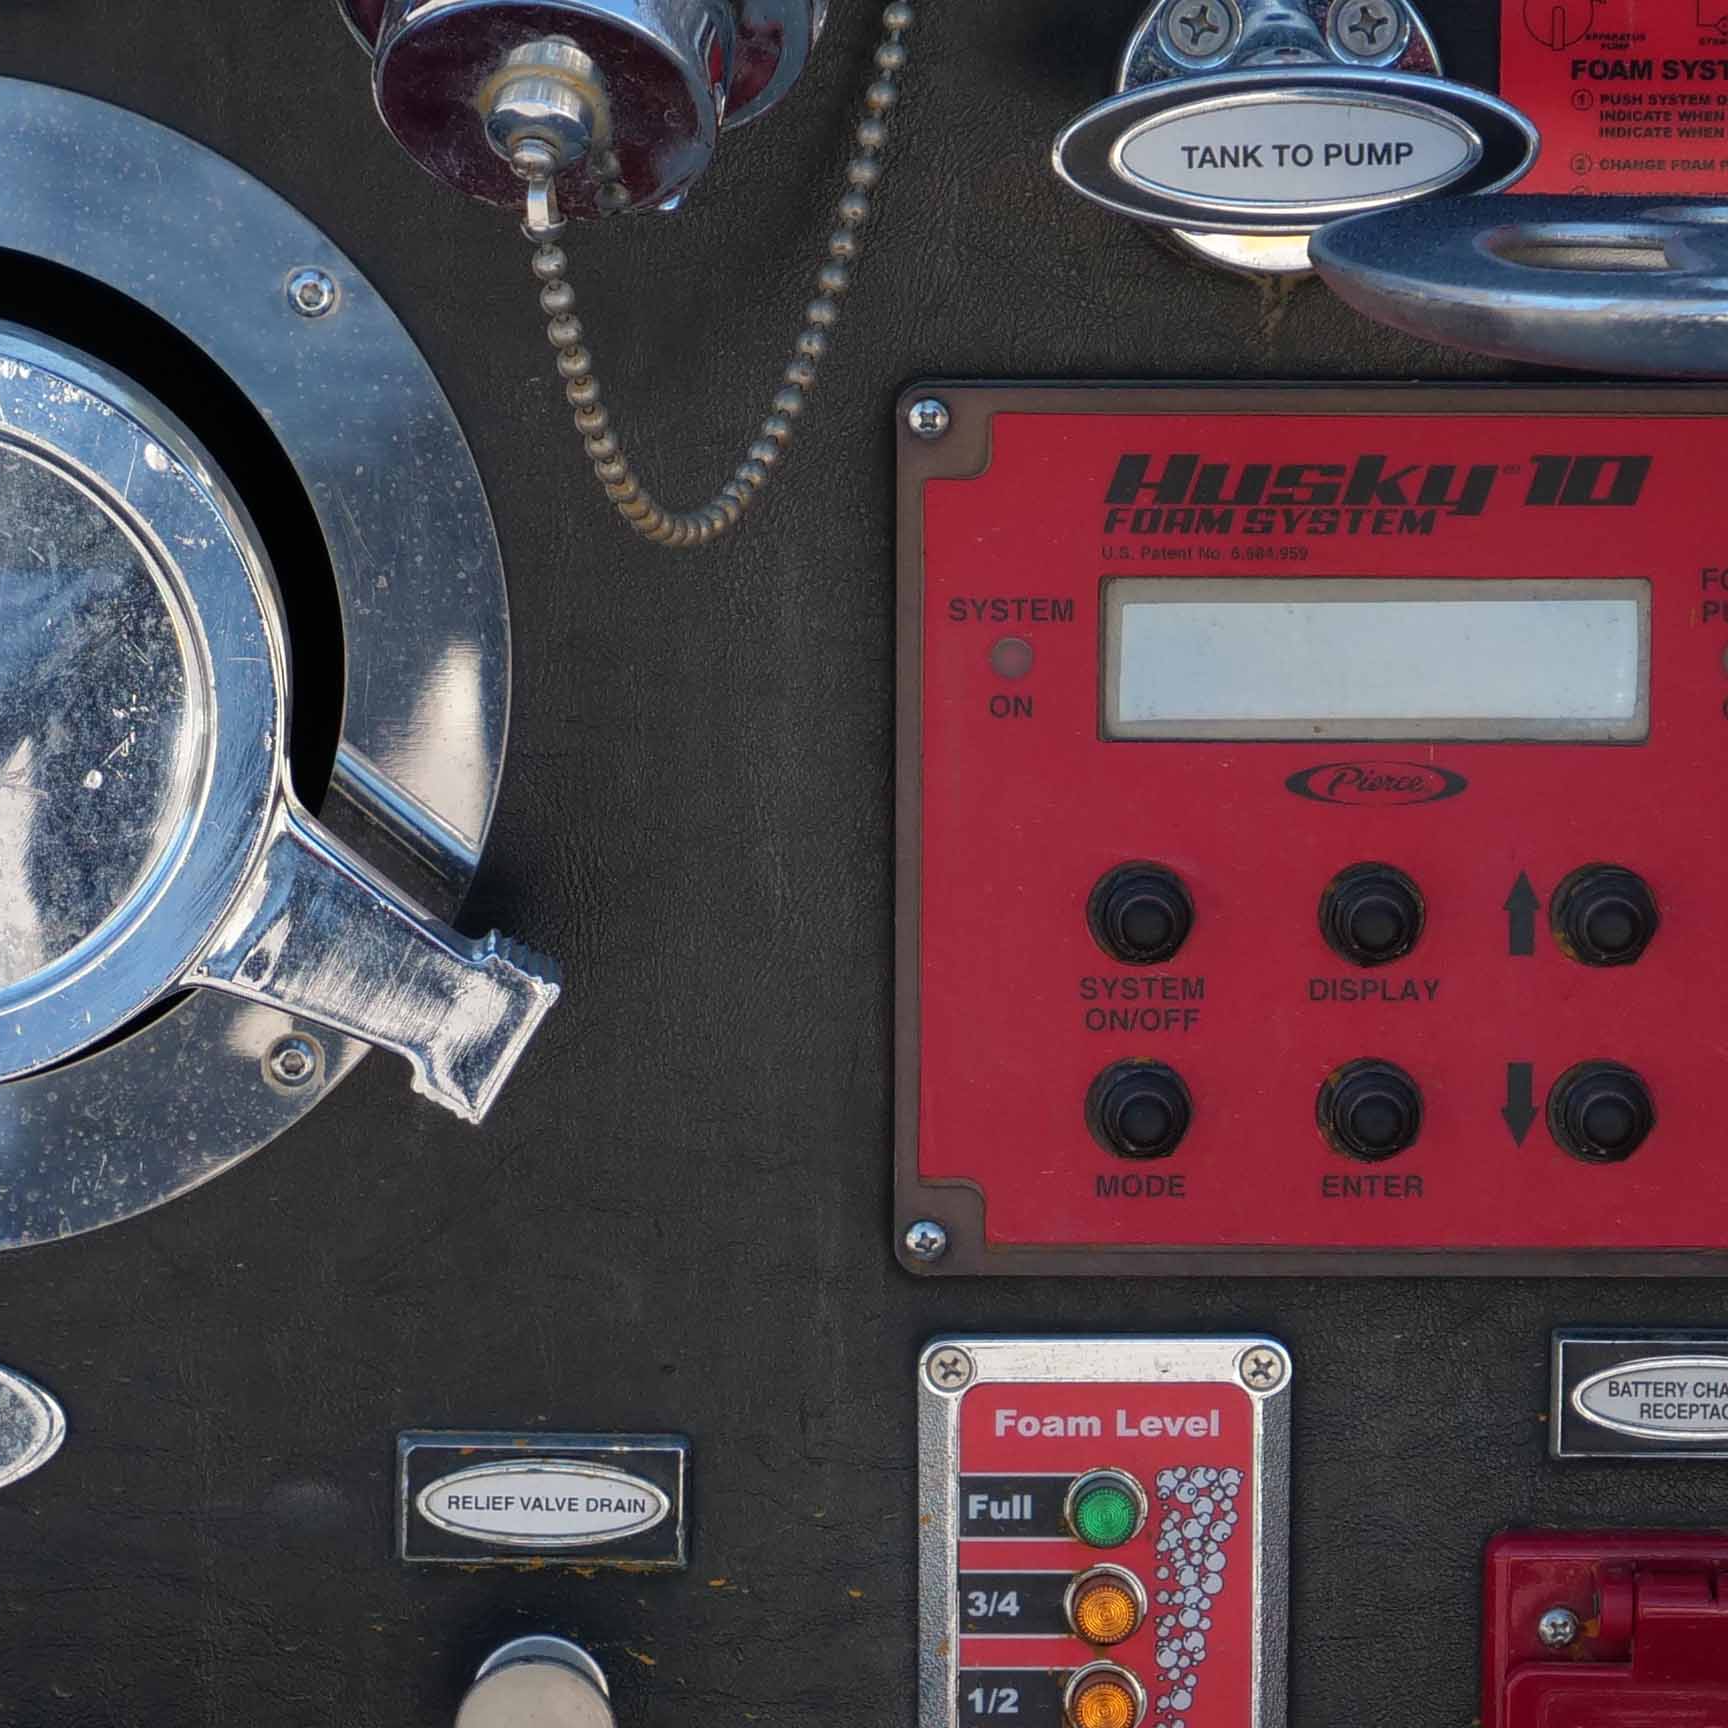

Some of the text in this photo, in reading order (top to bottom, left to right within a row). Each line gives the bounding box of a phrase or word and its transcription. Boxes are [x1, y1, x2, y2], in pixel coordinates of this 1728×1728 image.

[1571, 59, 1653, 81] FOAM
[1600, 94, 1643, 106] PUSH
[1647, 94, 1712, 106] SYSTEM
[1599, 127, 1673, 139] INDICATE
[1679, 127, 1725, 139] WHEN
[1180, 138, 1415, 170] TANK TO PUMP
[1103, 453, 1654, 517] Husky 10
[1102, 507, 1437, 537] FOAM SYSTEM
[1141, 546, 1192, 560] Patent
[948, 597, 1076, 624] SYSTEM
[988, 694, 1033, 720] ON
[1328, 766, 1424, 796] Pierce
[1079, 977, 1206, 1002] SYSTEM
[1309, 978, 1440, 1004] DISPLAY
[1085, 1007, 1201, 1033] ON/OFF
[1096, 1175, 1187, 1199] MODE
[1322, 1175, 1424, 1199] ENTER
[1608, 1381, 1688, 1398] BATTERY
[994, 1409, 1221, 1438] Foam Level
[447, 1495, 646, 1514] RELIEF VALVE DRAIN
[968, 1494, 1033, 1520] Full
[967, 1590, 1020, 1617] 3/4
[967, 1688, 1019, 1715] 1/2
